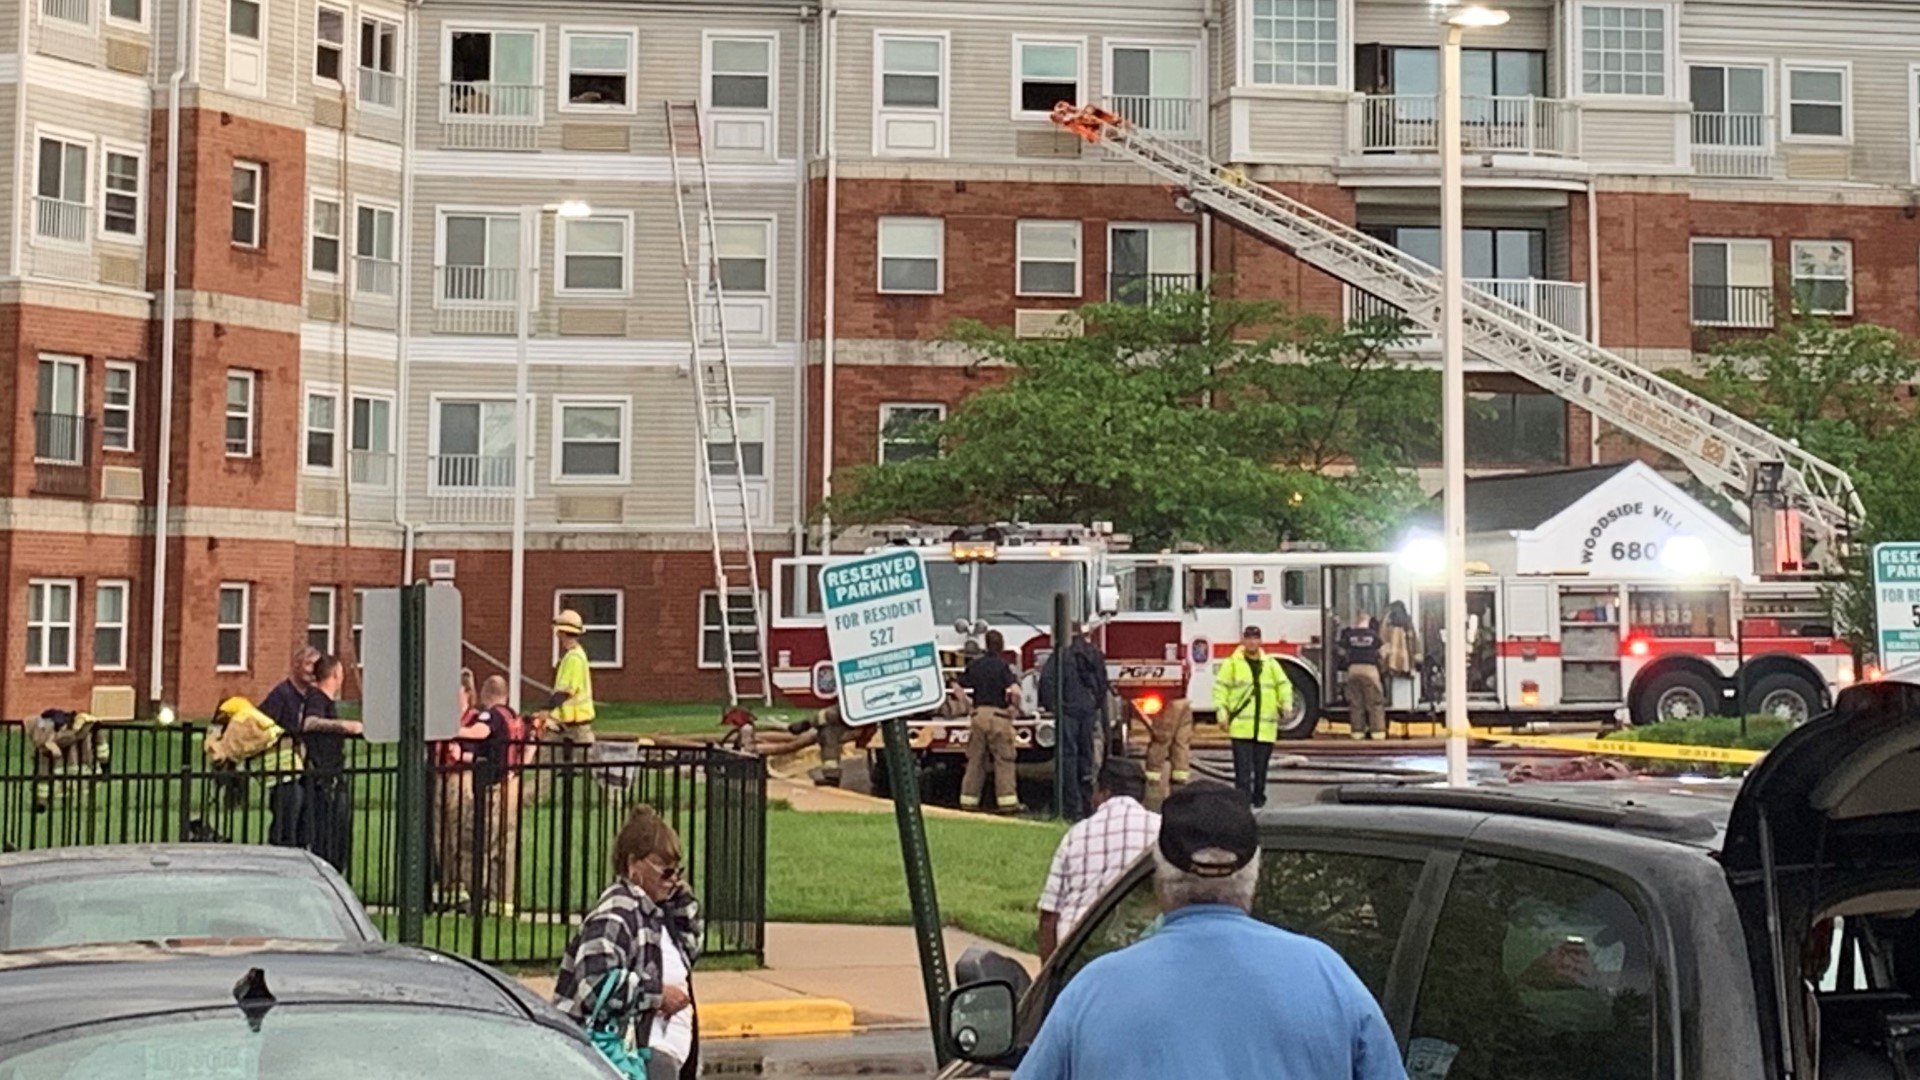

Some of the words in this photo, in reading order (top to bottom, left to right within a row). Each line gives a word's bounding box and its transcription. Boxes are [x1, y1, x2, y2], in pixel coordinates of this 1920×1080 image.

[1581, 502, 1643, 564] WOODSIDE
[1611, 541, 1658, 561] 680
[1880, 550, 1920, 564] RESE
[826, 556, 917, 588] RESERVED
[835, 573, 913, 602] PARKING
[835, 612, 860, 631] FOR
[863, 599, 922, 625] RESIDENT
[1912, 604, 1920, 628] 5
[870, 627, 894, 648] 527
[1119, 666, 1165, 678] PGFD
[949, 729, 970, 743] PG
